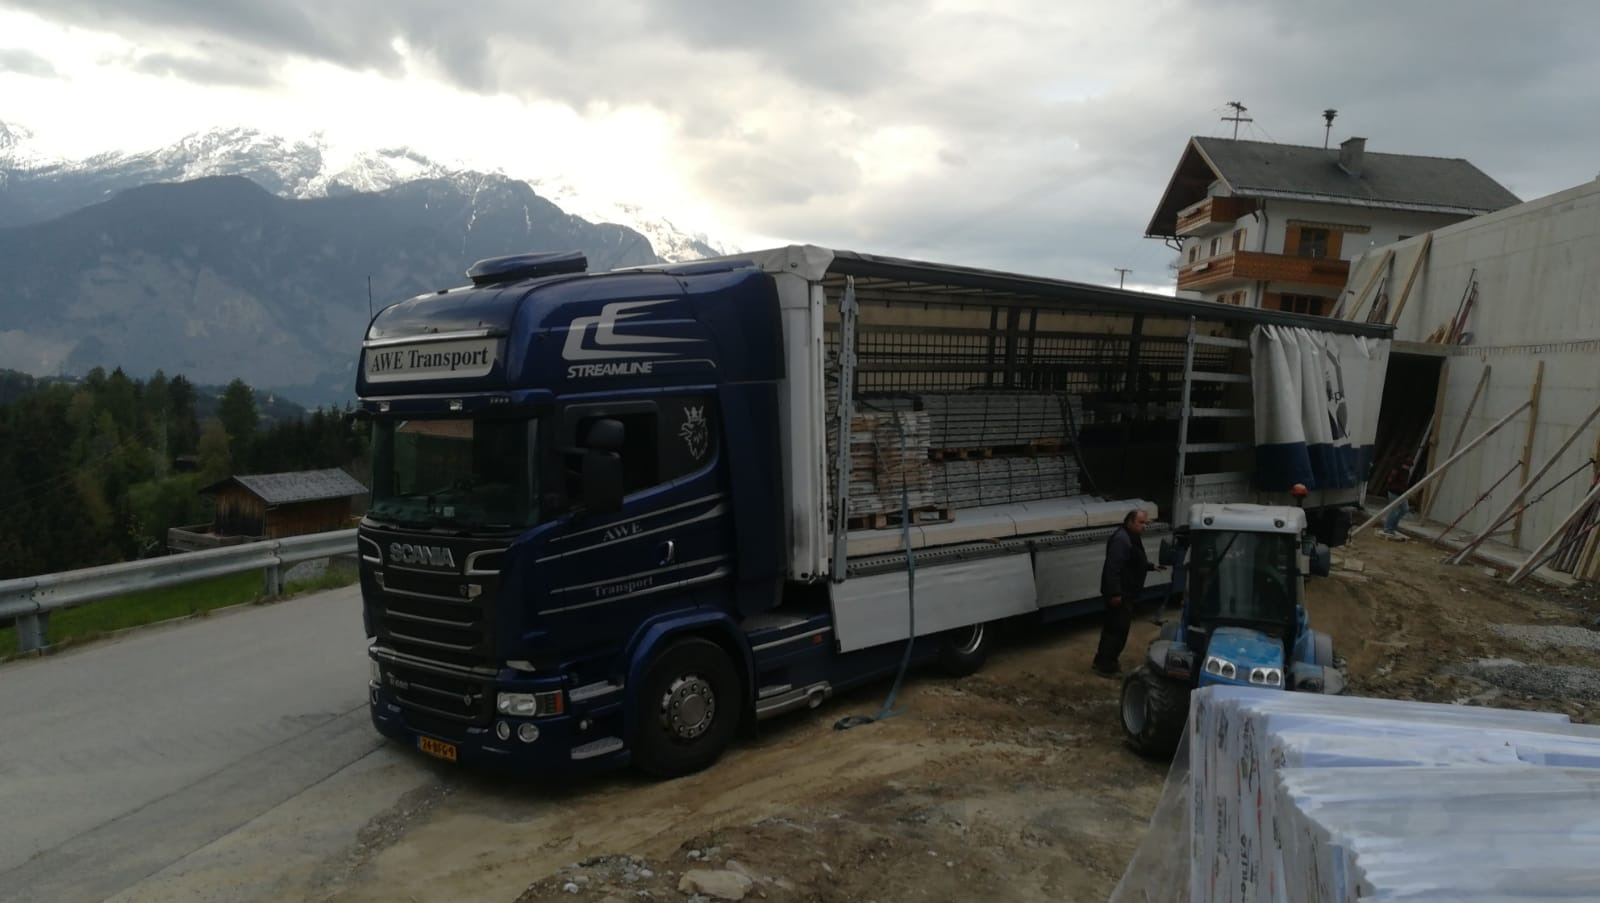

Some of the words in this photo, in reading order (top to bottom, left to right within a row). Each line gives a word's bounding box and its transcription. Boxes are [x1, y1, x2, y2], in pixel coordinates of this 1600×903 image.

[371, 350, 404, 373] AWE
[407, 346, 489, 372] Transport
[567, 361, 653, 379] STREAMLINE
[603, 521, 643, 542] AWE
[389, 542, 456, 568] SCANIA
[592, 576, 654, 598] Transport
